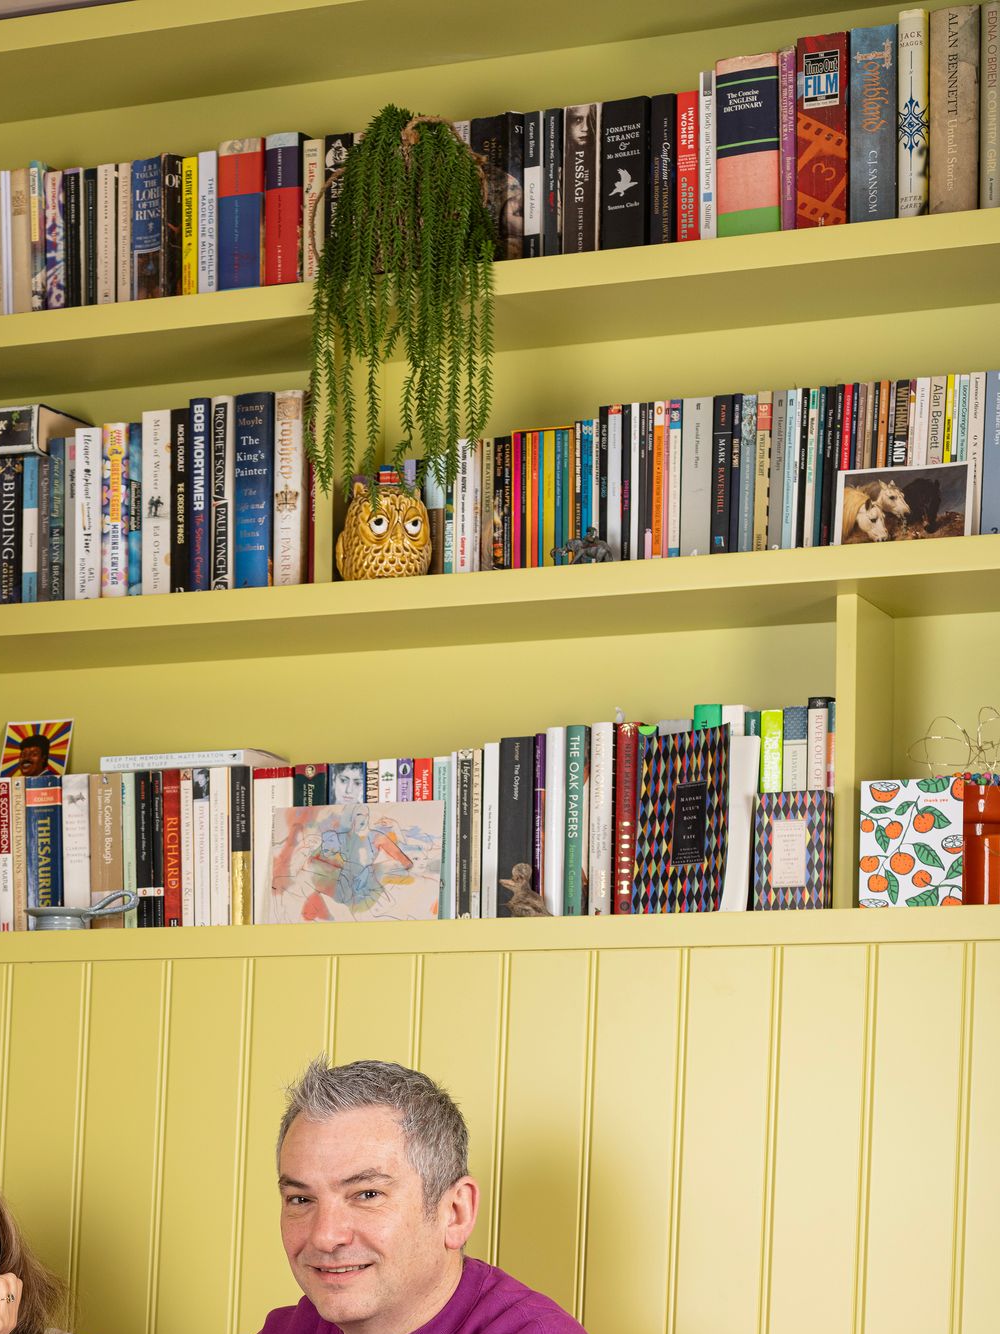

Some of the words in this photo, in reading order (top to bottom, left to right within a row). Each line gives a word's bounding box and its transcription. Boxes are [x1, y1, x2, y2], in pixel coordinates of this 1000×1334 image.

[948, 12, 959, 48] ALAN
[986, 10, 998, 42] EDNA
[986, 44, 998, 88] O'BRIEN
[804, 72, 838, 97] FILM
[853, 39, 893, 134] Tombland
[948, 54, 959, 116] BENNETT
[704, 99, 712, 112] The
[723, 100, 764, 113] DICTIONARY
[729, 96, 758, 106] ENGLISH
[606, 122, 641, 136] JONATHAN
[704, 112, 712, 131] Body
[986, 90, 998, 146] COUNTRY
[606, 132, 640, 142] STRANGE
[704, 131, 712, 145] and
[948, 118, 959, 154] Untold
[704, 146, 712, 166] Social
[986, 148, 997, 176] GIRL
[184, 169, 192, 196] CREATIVE
[574, 150, 584, 203] PASSAGE
[704, 167, 712, 190] Theory
[948, 158, 959, 192] Stories
[868, 168, 878, 214] SANSOM
[184, 196, 192, 238] SUPERPOWERS
[704, 204, 712, 230] Shilling
[208, 227, 214, 240] OF
[930, 384, 943, 408] Alan
[193, 404, 205, 432] BOB
[895, 386, 908, 438] WITHNAIL
[152, 419, 160, 446] Minds
[214, 407, 225, 459] PROPHET
[240, 436, 260, 446] The
[930, 410, 943, 450] Bennett
[152, 448, 160, 458] of
[236, 450, 266, 462] King's
[717, 438, 725, 464] MARK
[892, 440, 906, 462] AND
[152, 460, 160, 490] Winter
[193, 436, 205, 511] MORTIMER
[214, 460, 225, 492] SONG
[234, 468, 268, 478] Painter
[717, 467, 725, 514] RAVENHILL
[2, 482, 15, 560] BINDING
[152, 525, 160, 538] Ed
[177, 514, 184, 523] OF
[216, 506, 227, 536] PAUL
[52, 528, 60, 563] MELVYN
[216, 536, 227, 574] LYNCH
[152, 540, 160, 590] O'Loughlin
[52, 565, 60, 595] BRAGG
[814, 714, 823, 742] RIVER
[512, 742, 520, 761] Homer
[568, 735, 580, 758] THE
[814, 744, 823, 762] OUT
[366, 768, 378, 792] MAYA
[512, 764, 520, 775] The
[568, 762, 579, 790] OAK
[814, 763, 823, 780] OF
[0, 782, 8, 796] GIL
[103, 788, 113, 804] The
[512, 776, 520, 801] Odyssey
[0, 797, 10, 854] SCOTT-HERON
[103, 805, 113, 835] Golden
[567, 794, 578, 839] PAPERS
[37, 816, 51, 908] THESAURUS
[103, 836, 113, 865] Bough
[568, 870, 576, 898] Canton
